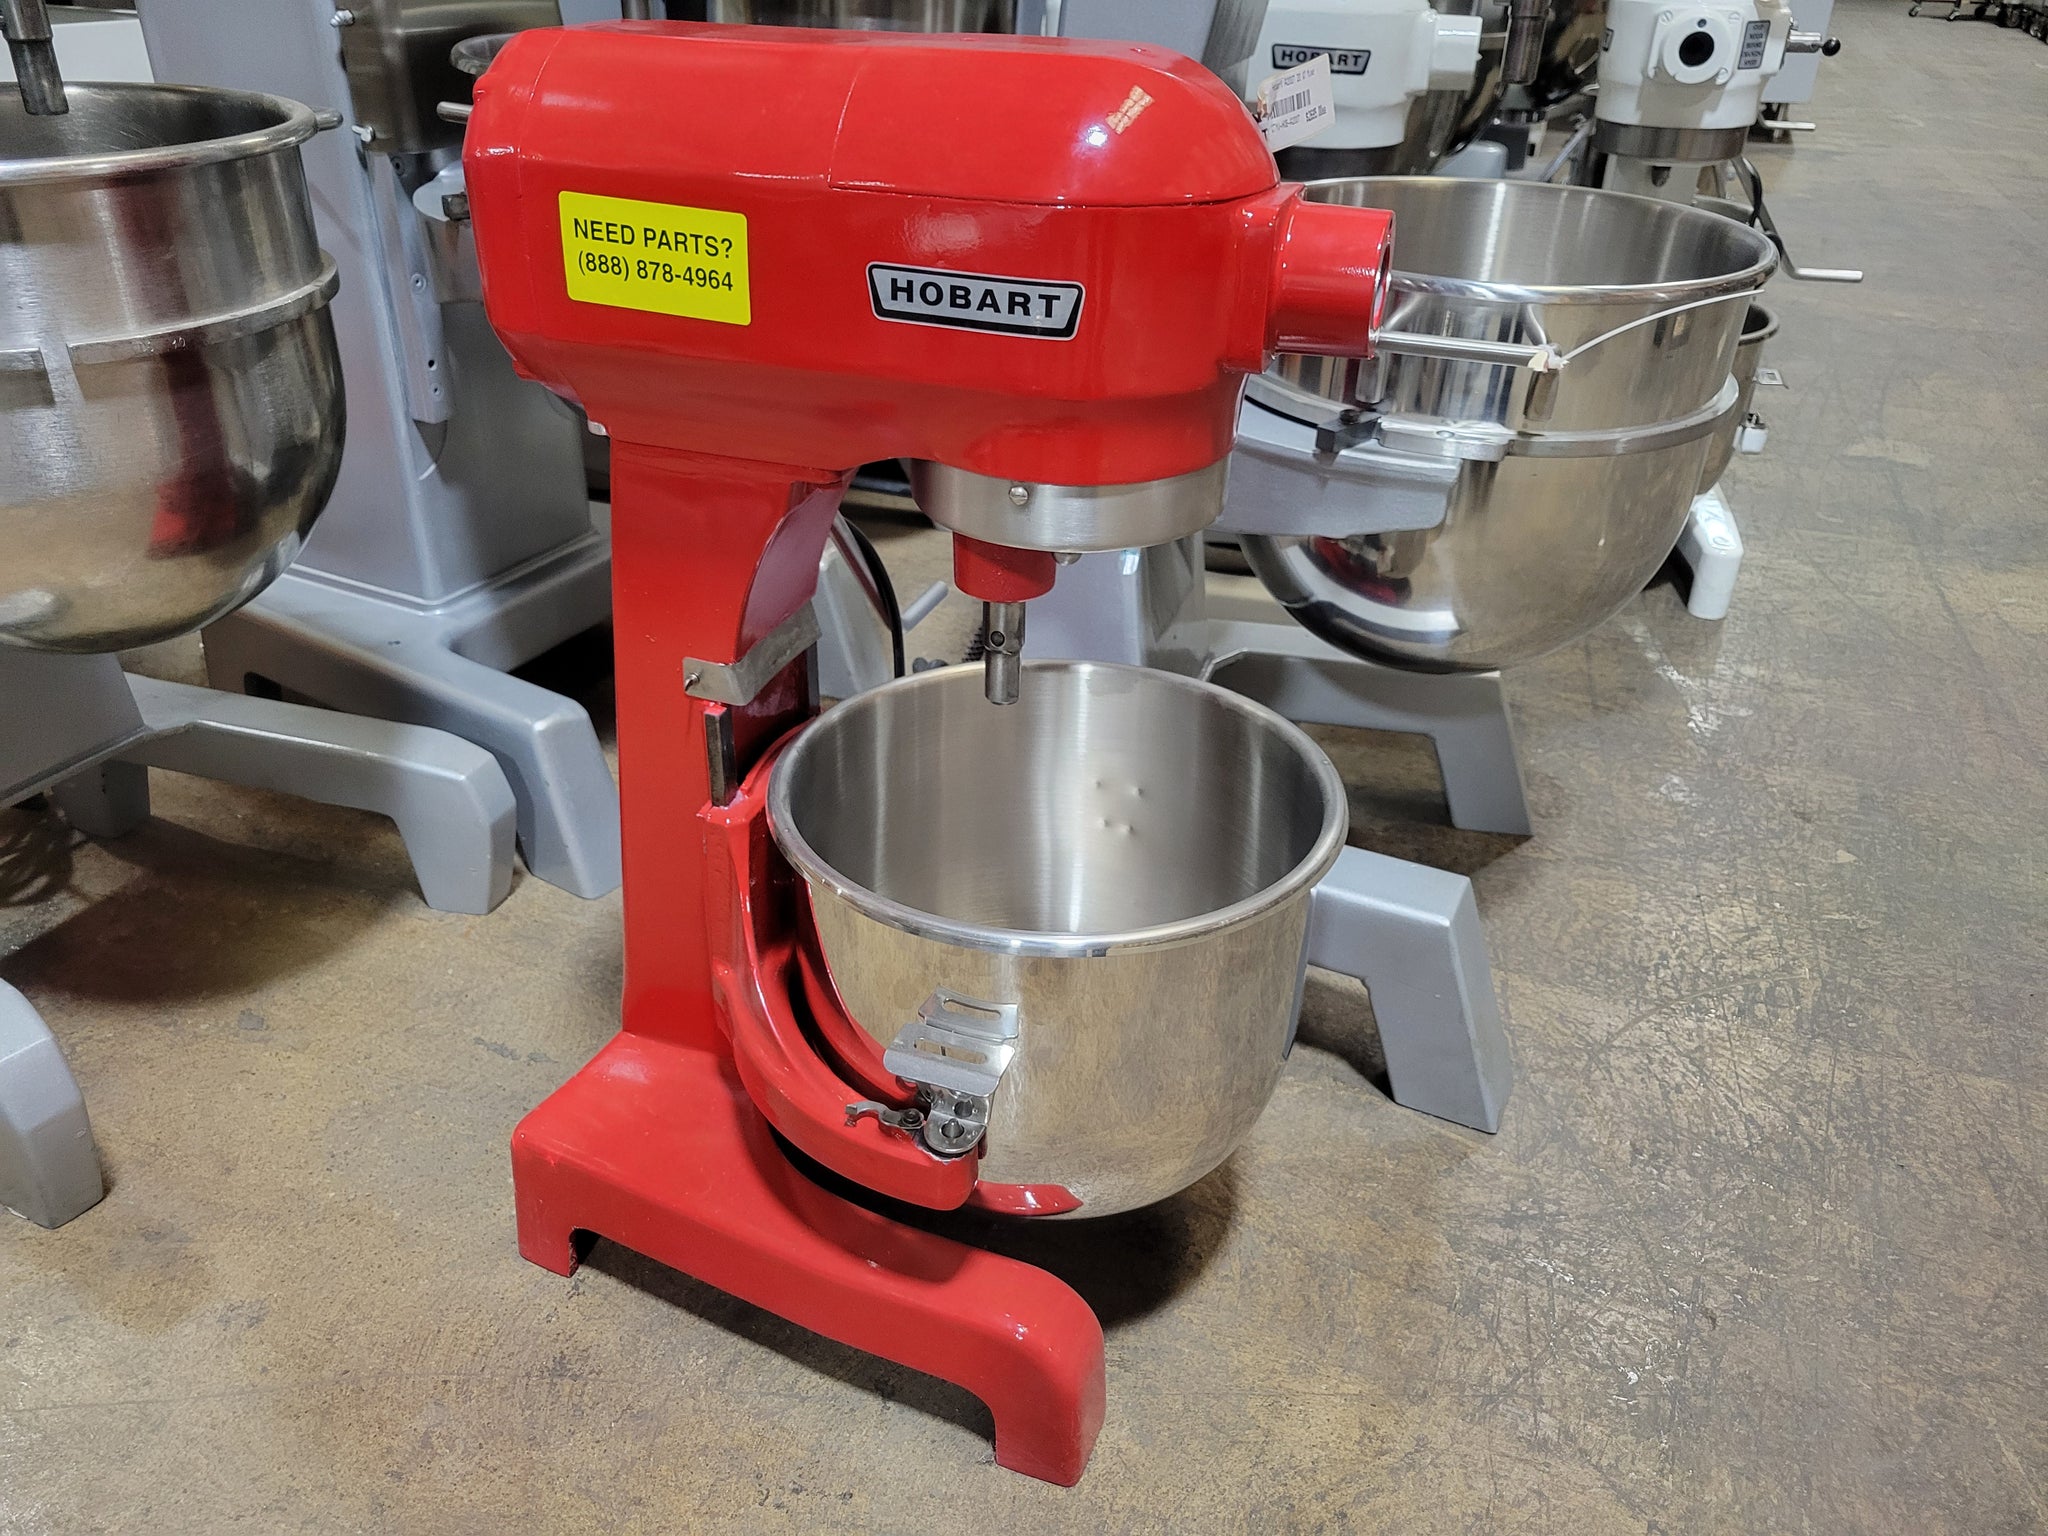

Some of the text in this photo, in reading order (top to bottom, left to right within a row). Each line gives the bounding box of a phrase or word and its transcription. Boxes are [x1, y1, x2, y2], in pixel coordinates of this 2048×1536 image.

[573, 217, 733, 259] NEED PARTS?
[578, 250, 734, 292] (888) 878-4964
[890, 277, 1061, 319] HOBART
